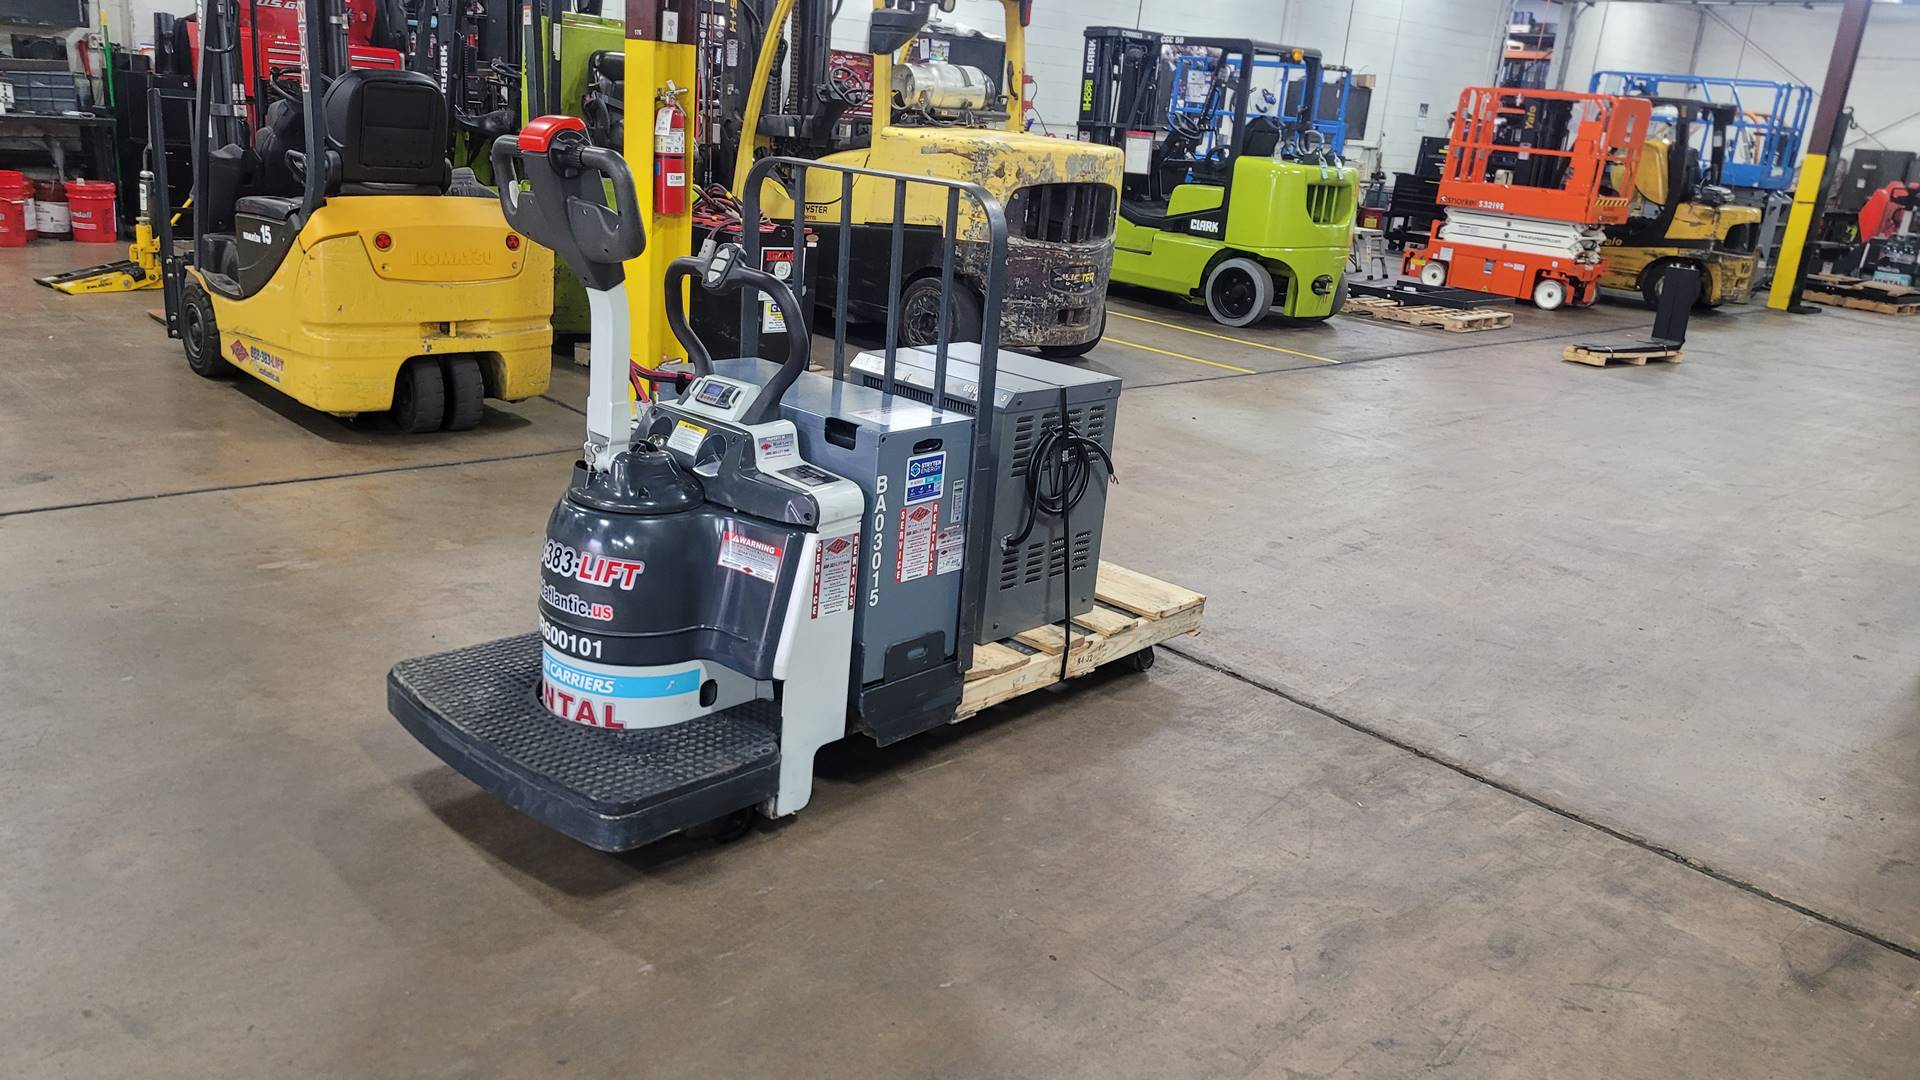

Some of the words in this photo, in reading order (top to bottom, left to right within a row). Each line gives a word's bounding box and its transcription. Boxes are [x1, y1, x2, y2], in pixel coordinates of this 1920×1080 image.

[1086, 39, 1097, 74] CLARK
[260, 224, 272, 245] 15
[1190, 218, 1219, 233] CLARK
[739, 535, 776, 555] WARNING
[868, 474, 889, 608] BA03015
[896, 511, 906, 580] SERVICE
[927, 502, 939, 572] RENTALS
[811, 541, 823, 616] SERVICE
[848, 535, 860, 607] RENTALS
[550, 663, 616, 694] CARRIERS
